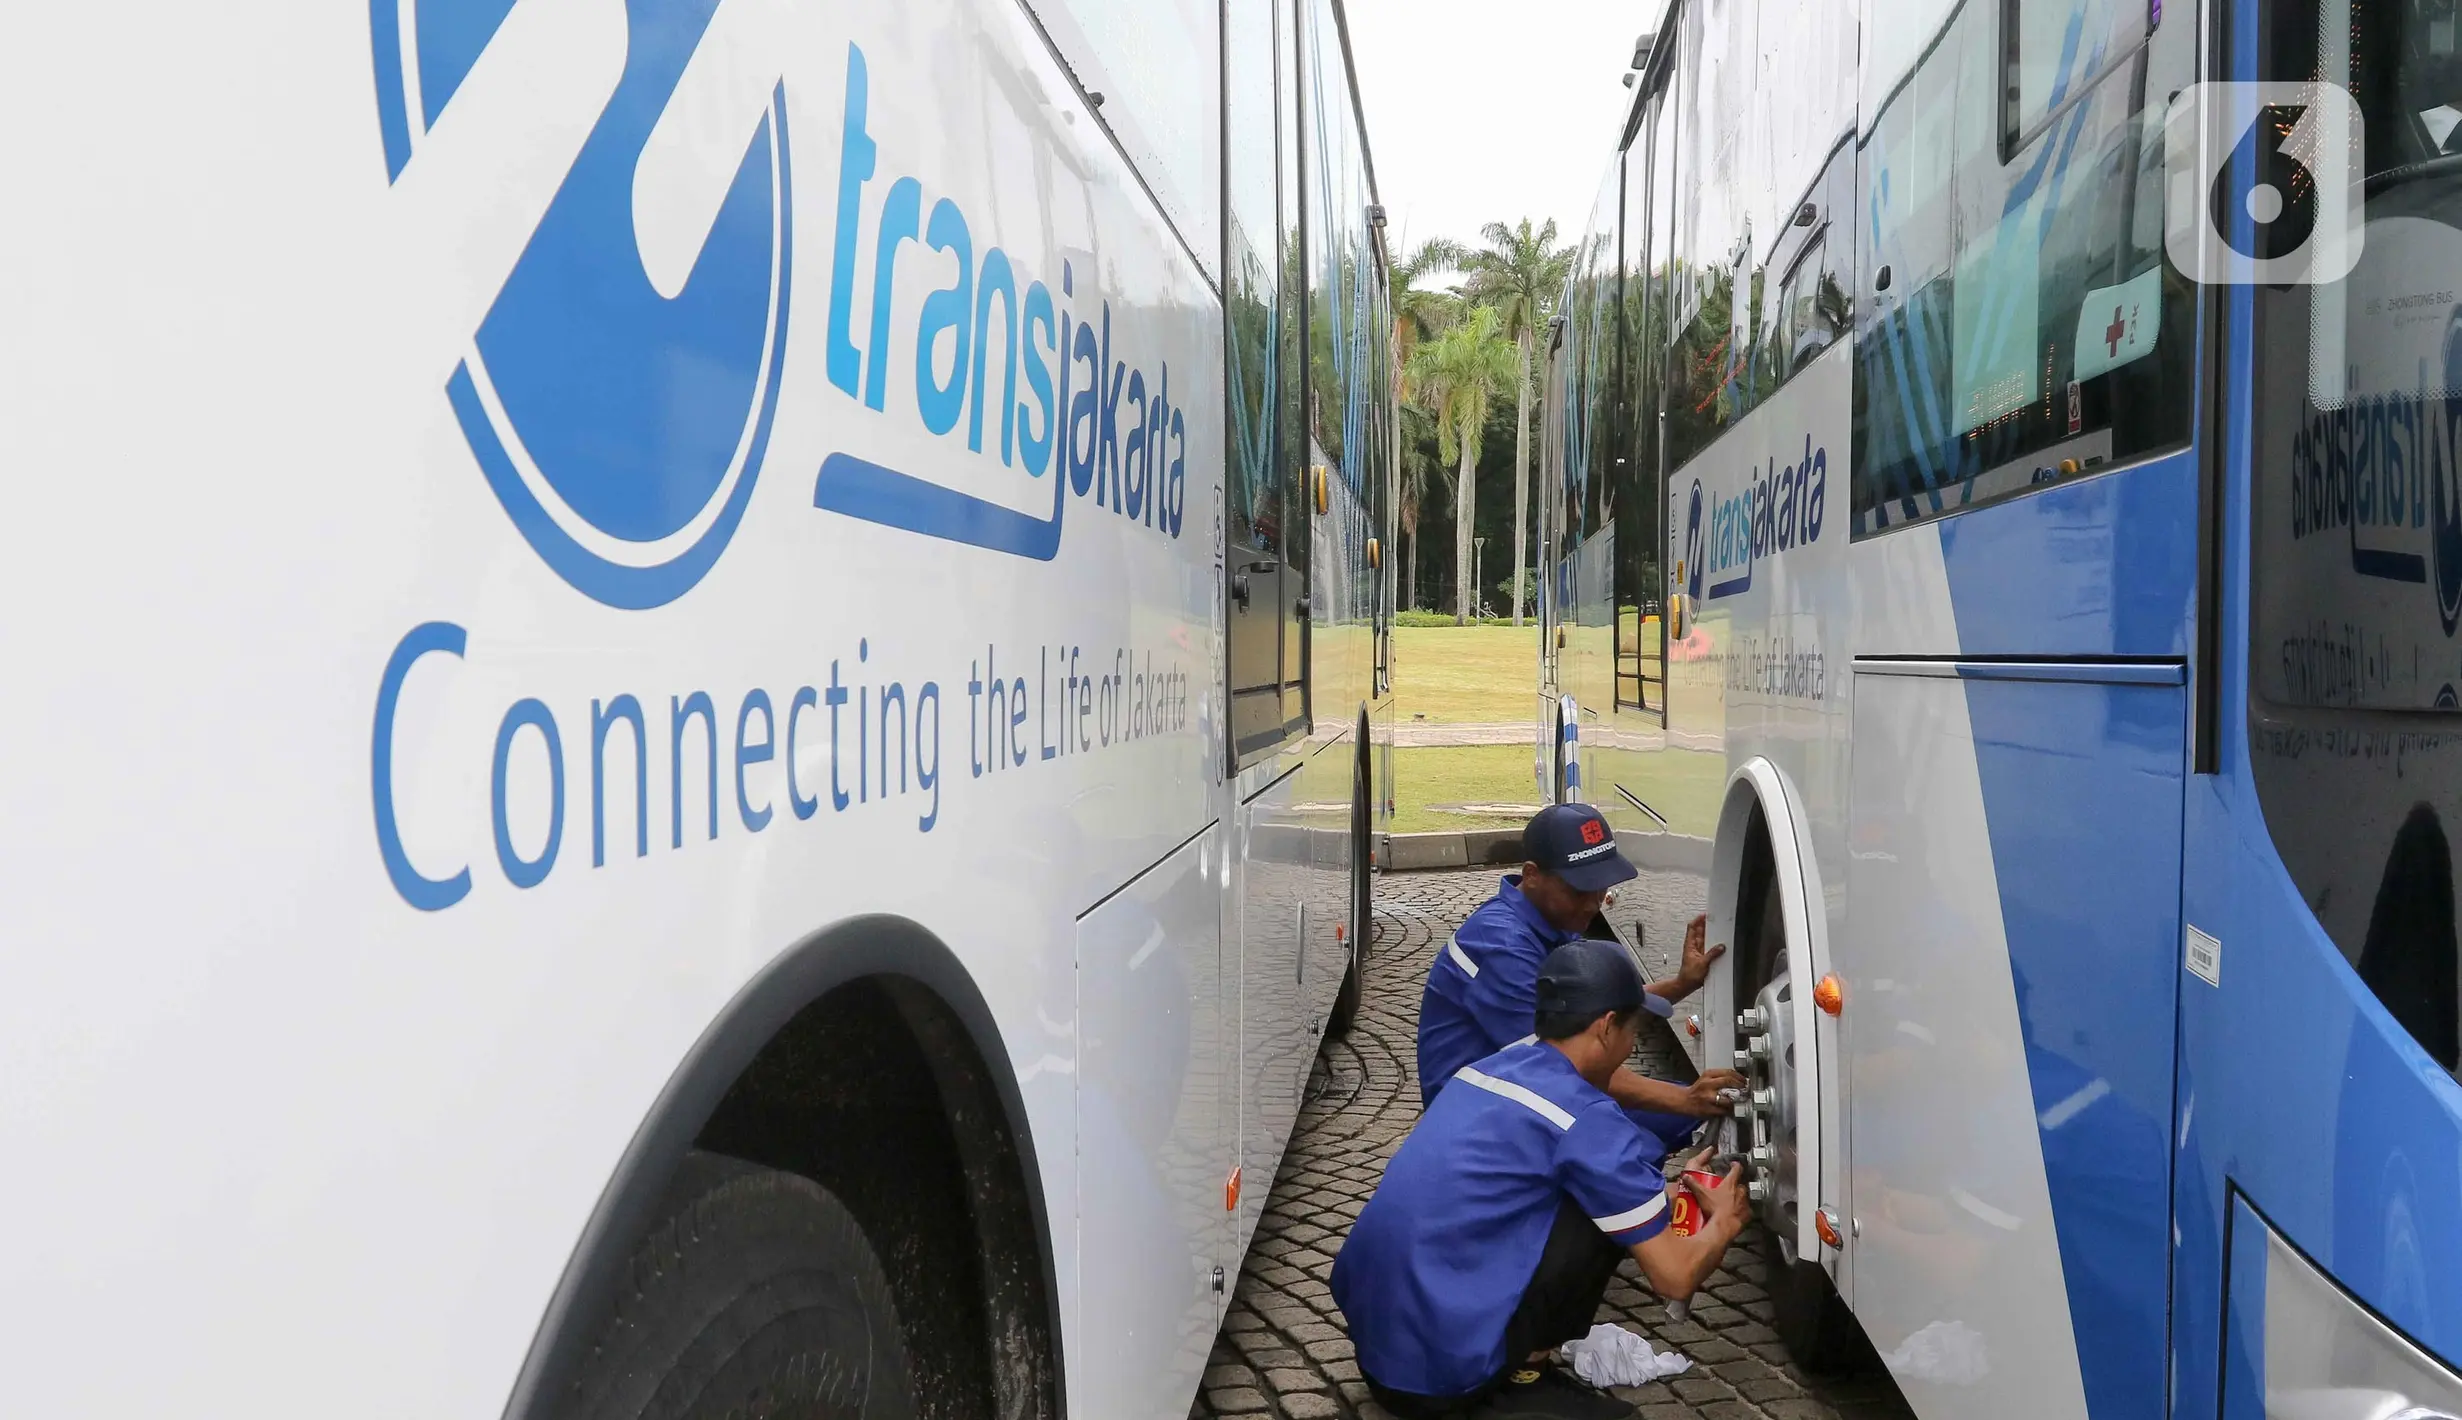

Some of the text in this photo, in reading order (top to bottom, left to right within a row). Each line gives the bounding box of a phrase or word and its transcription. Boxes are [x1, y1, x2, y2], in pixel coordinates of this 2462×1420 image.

[826, 40, 1185, 548] transjakarta
[2436, 290, 2454, 305] BUS
[1709, 433, 1827, 575] transjakarta
[1778, 636, 1825, 701] Jakarta
[371, 620, 1188, 912] Connecting the Life of Jakarta
